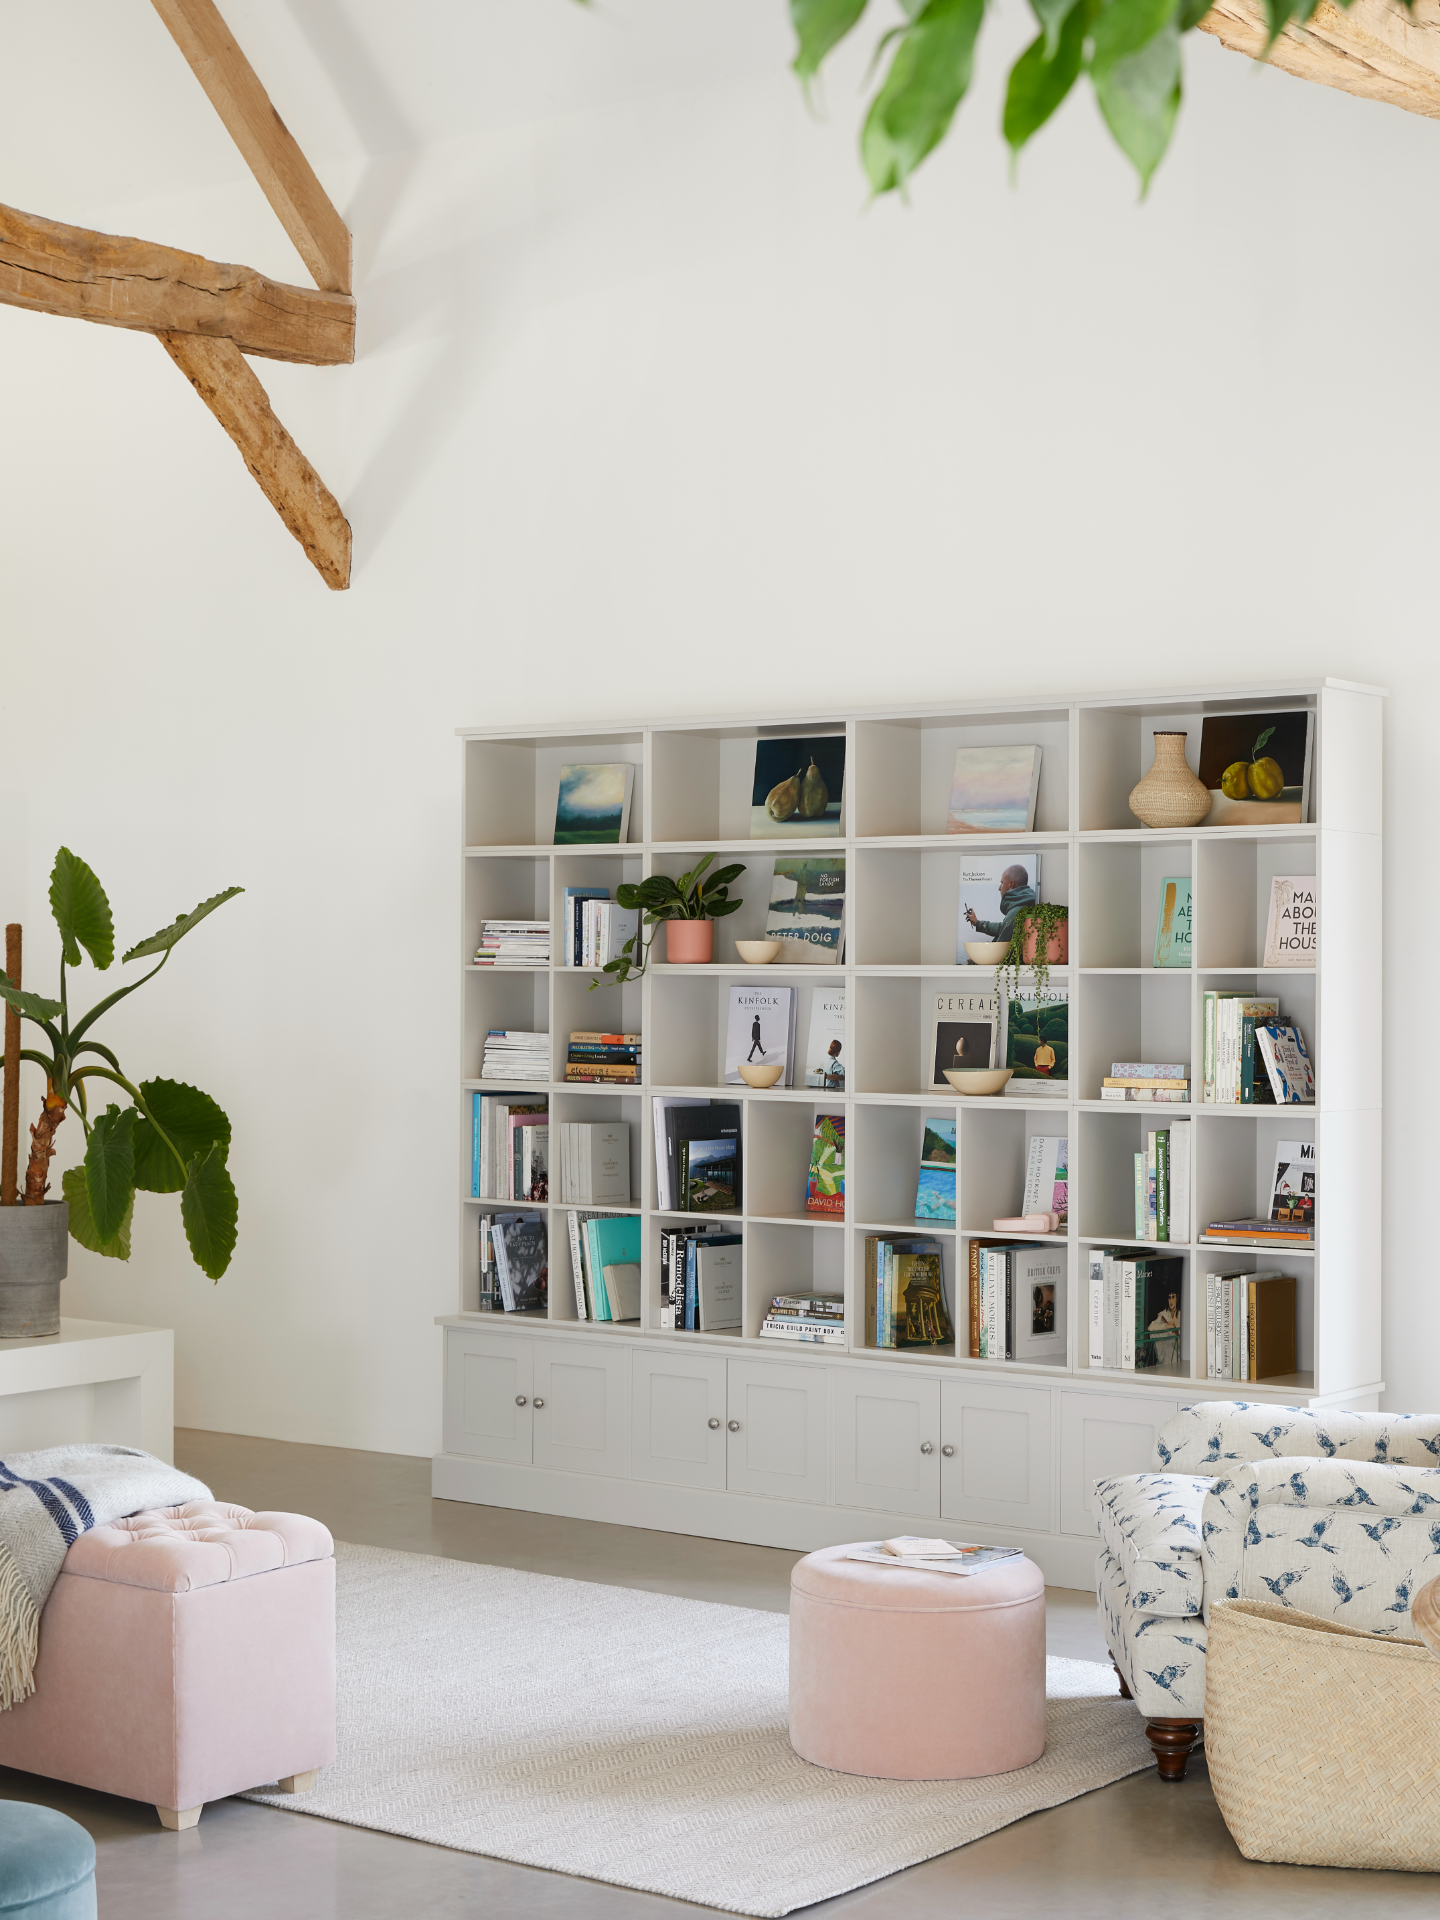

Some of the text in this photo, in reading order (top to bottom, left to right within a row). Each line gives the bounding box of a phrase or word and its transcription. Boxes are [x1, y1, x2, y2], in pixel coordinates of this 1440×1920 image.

[1293, 891, 1316, 903] MA
[1282, 906, 1316, 919] ABO
[771, 933, 832, 942] PETER DOIG
[1279, 937, 1316, 949] HOUS
[738, 997, 779, 1005] KINFOLK
[938, 998, 994, 1010] CEREAL
[571, 1066, 603, 1075] etcetera
[1130, 1079, 1169, 1088] STYLED
[1301, 1144, 1315, 1159] Mi
[1029, 1168, 1034, 1176] IN
[1033, 1166, 1041, 1204] HOCKNEY
[807, 1197, 833, 1206] DAVID
[577, 1211, 599, 1221] GREAT
[1137, 1270, 1153, 1278] Manet
[675, 1250, 684, 1315] Remodelista
